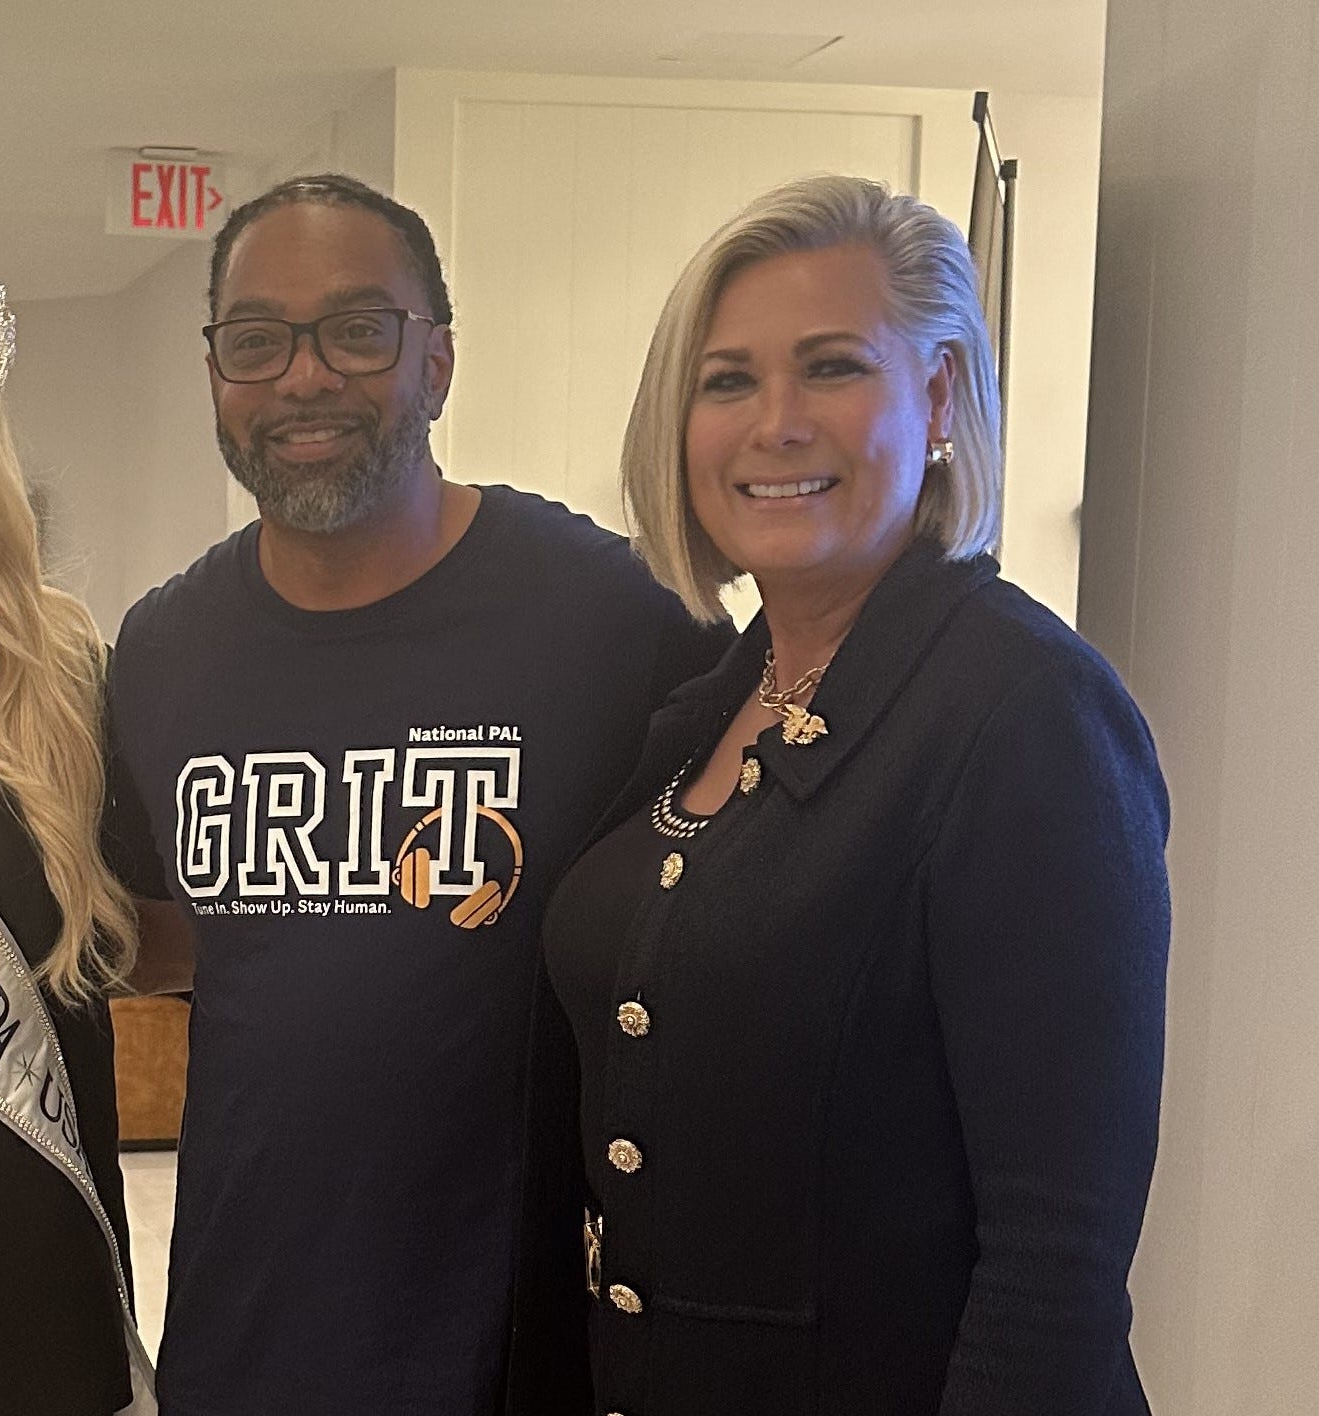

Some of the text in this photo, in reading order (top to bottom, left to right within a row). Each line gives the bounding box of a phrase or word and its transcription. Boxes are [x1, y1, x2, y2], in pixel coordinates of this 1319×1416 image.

[132, 163, 211, 230] EXIT
[408, 725, 522, 742] National PAL
[175, 747, 521, 898] GRIT
[192, 899, 392, 917] Tune In. Show Up. Stay Human.
[40, 1067, 83, 1160] US
